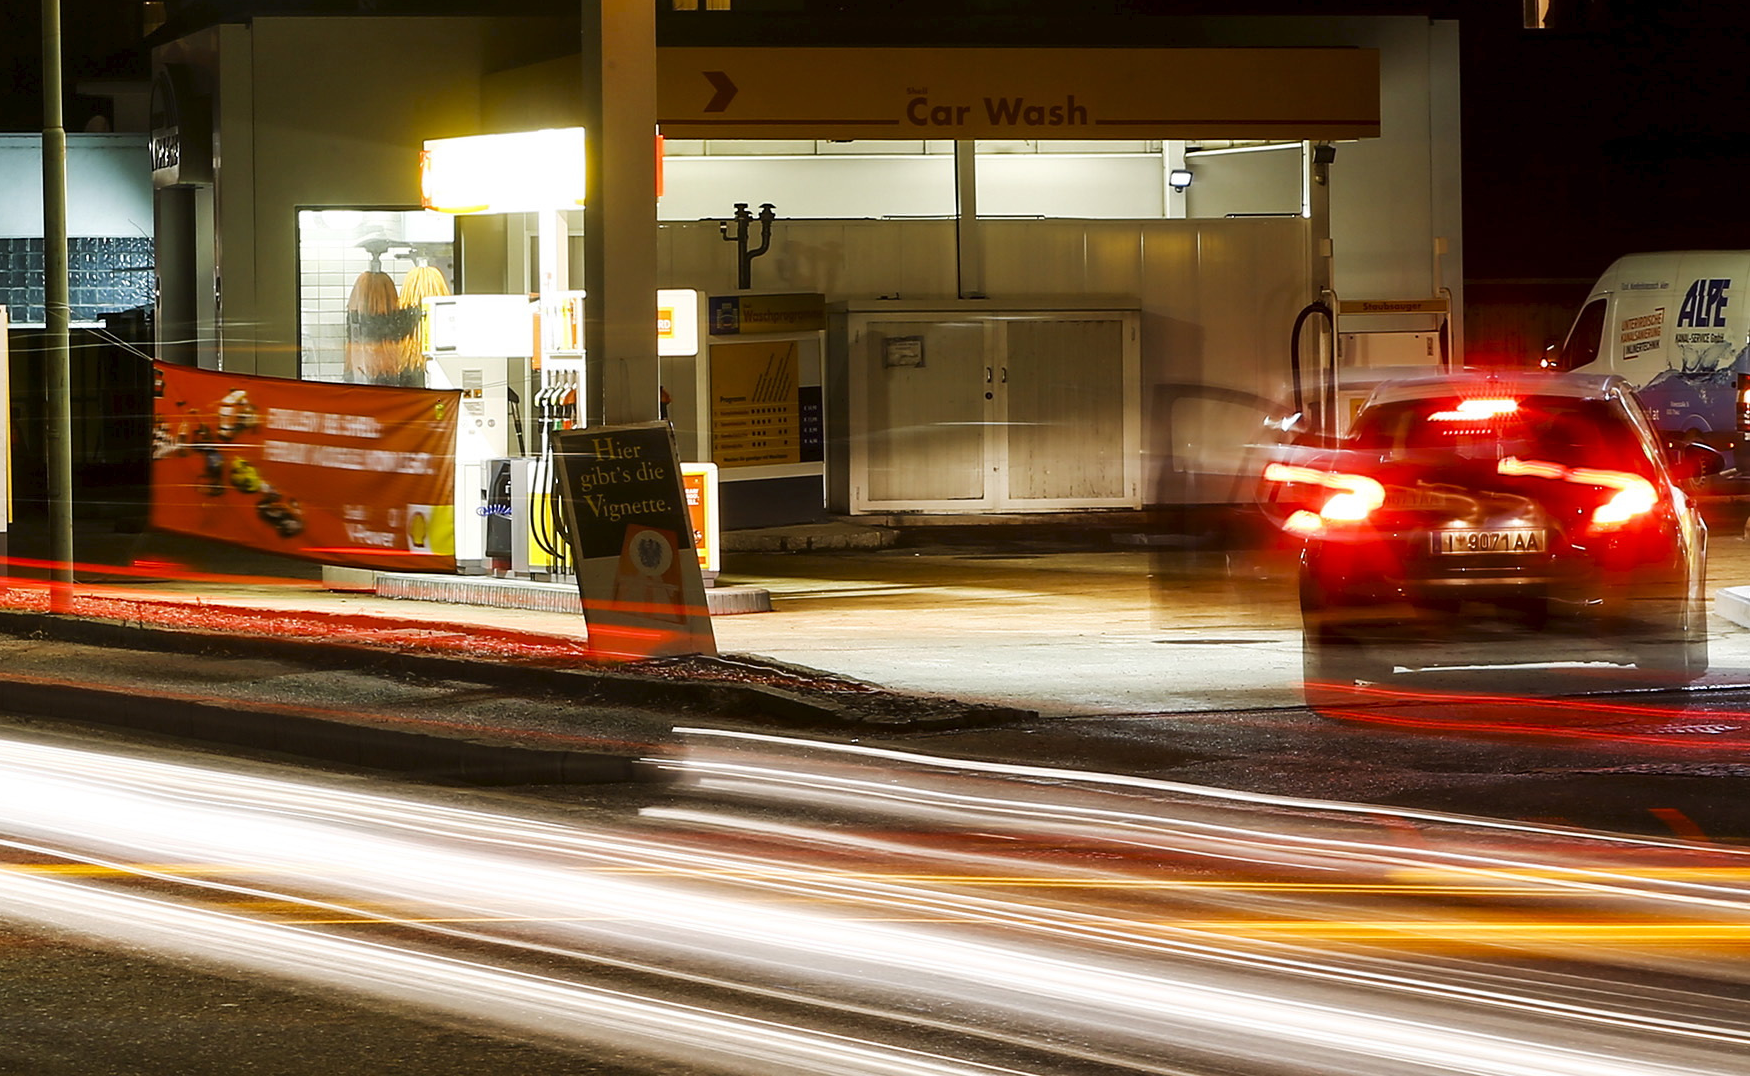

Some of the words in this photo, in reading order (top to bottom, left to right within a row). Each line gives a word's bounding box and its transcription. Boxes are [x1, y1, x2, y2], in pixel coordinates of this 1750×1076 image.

[906, 87, 928, 95] Shell
[906, 97, 971, 126] Car
[983, 95, 1088, 126] Wash
[1363, 302, 1422, 312] Staubsauger
[1676, 279, 1731, 328] ALPE
[592, 438, 641, 462] Hier
[580, 467, 631, 492] gibt's
[636, 462, 665, 482] die
[583, 494, 672, 522] Vignette.
